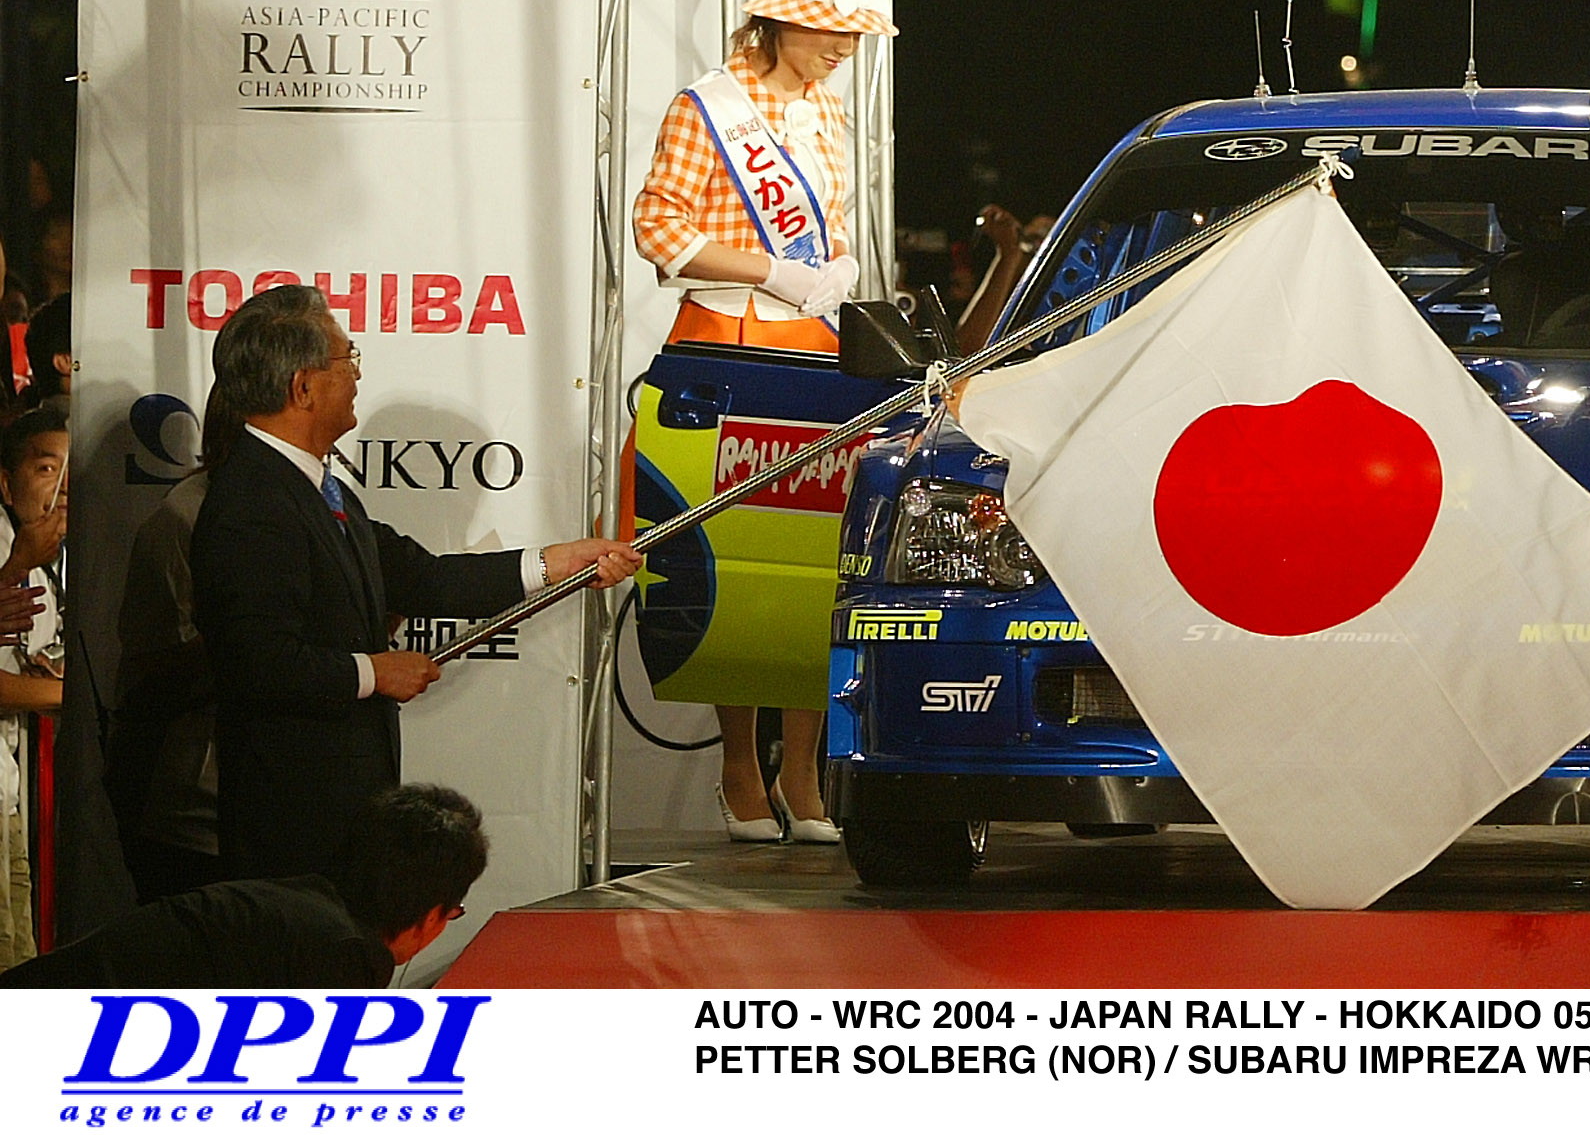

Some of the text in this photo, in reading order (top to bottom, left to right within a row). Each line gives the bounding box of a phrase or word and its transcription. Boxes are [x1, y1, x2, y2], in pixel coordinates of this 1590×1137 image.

[240, 6, 431, 29] ASIA-PACIFIC
[239, 32, 428, 77] RALLY
[238, 80, 428, 100] CHAMPIONSHIP
[743, 142, 807, 240] とかち
[130, 269, 526, 336] TOHIBA
[331, 440, 524, 491] NKYO
[847, 609, 943, 640] PIRELLI
